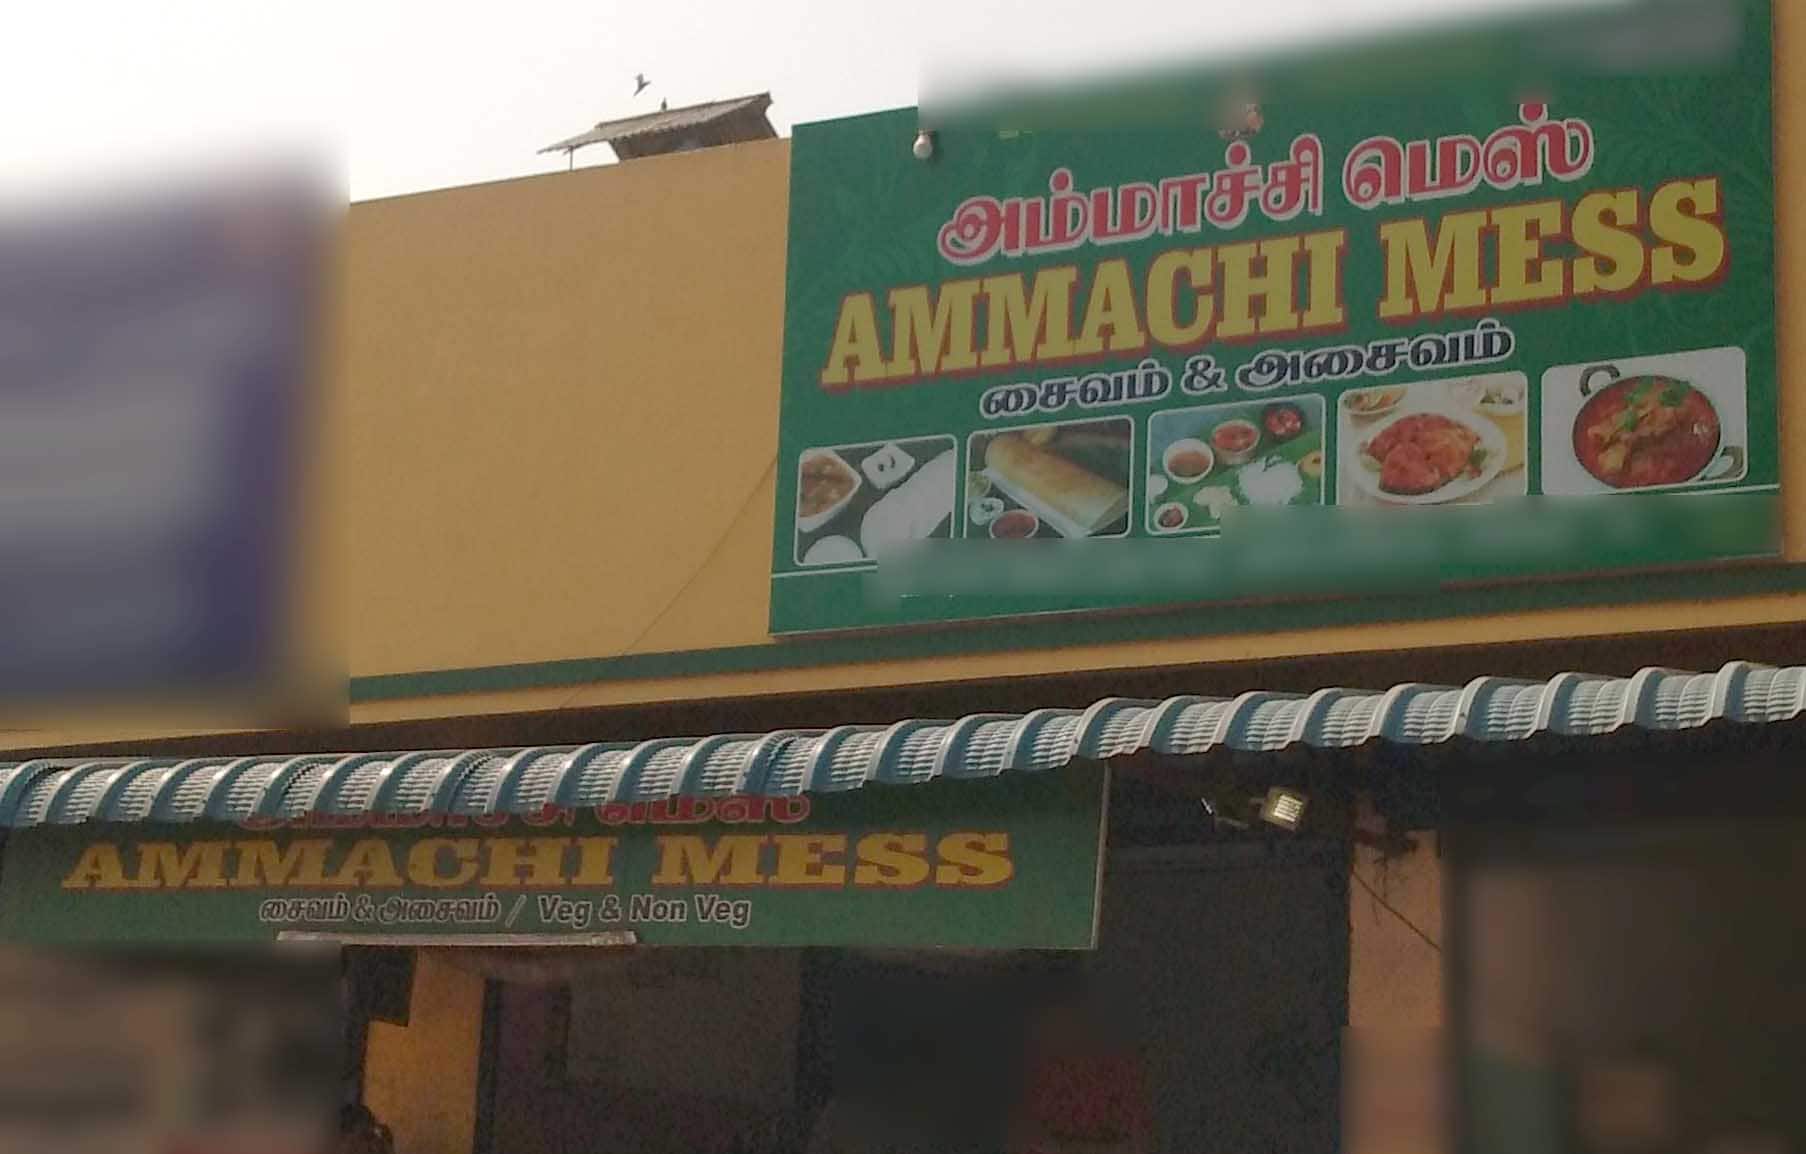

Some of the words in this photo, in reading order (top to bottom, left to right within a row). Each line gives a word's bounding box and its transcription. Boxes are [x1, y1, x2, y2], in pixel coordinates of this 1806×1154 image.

[938, 135, 1322, 264] அம்மாச்சி
[1343, 103, 1593, 209] மெஸ்
[821, 230, 1346, 389] AMMACHI
[1379, 177, 1730, 326] MESS
[980, 359, 1172, 418] சைவம்
[1183, 355, 1227, 393] &
[1236, 319, 1516, 391] அசைவம்
[61, 836, 615, 890] AMMACHI
[651, 831, 1015, 889] MESS
[259, 892, 351, 922] சைவம்
[351, 893, 376, 922] &
[377, 892, 500, 923] அசைவம்
[538, 894, 592, 927] Veg
[599, 894, 621, 923] &
[628, 894, 688, 923] Non
[694, 894, 751, 928] Veg
